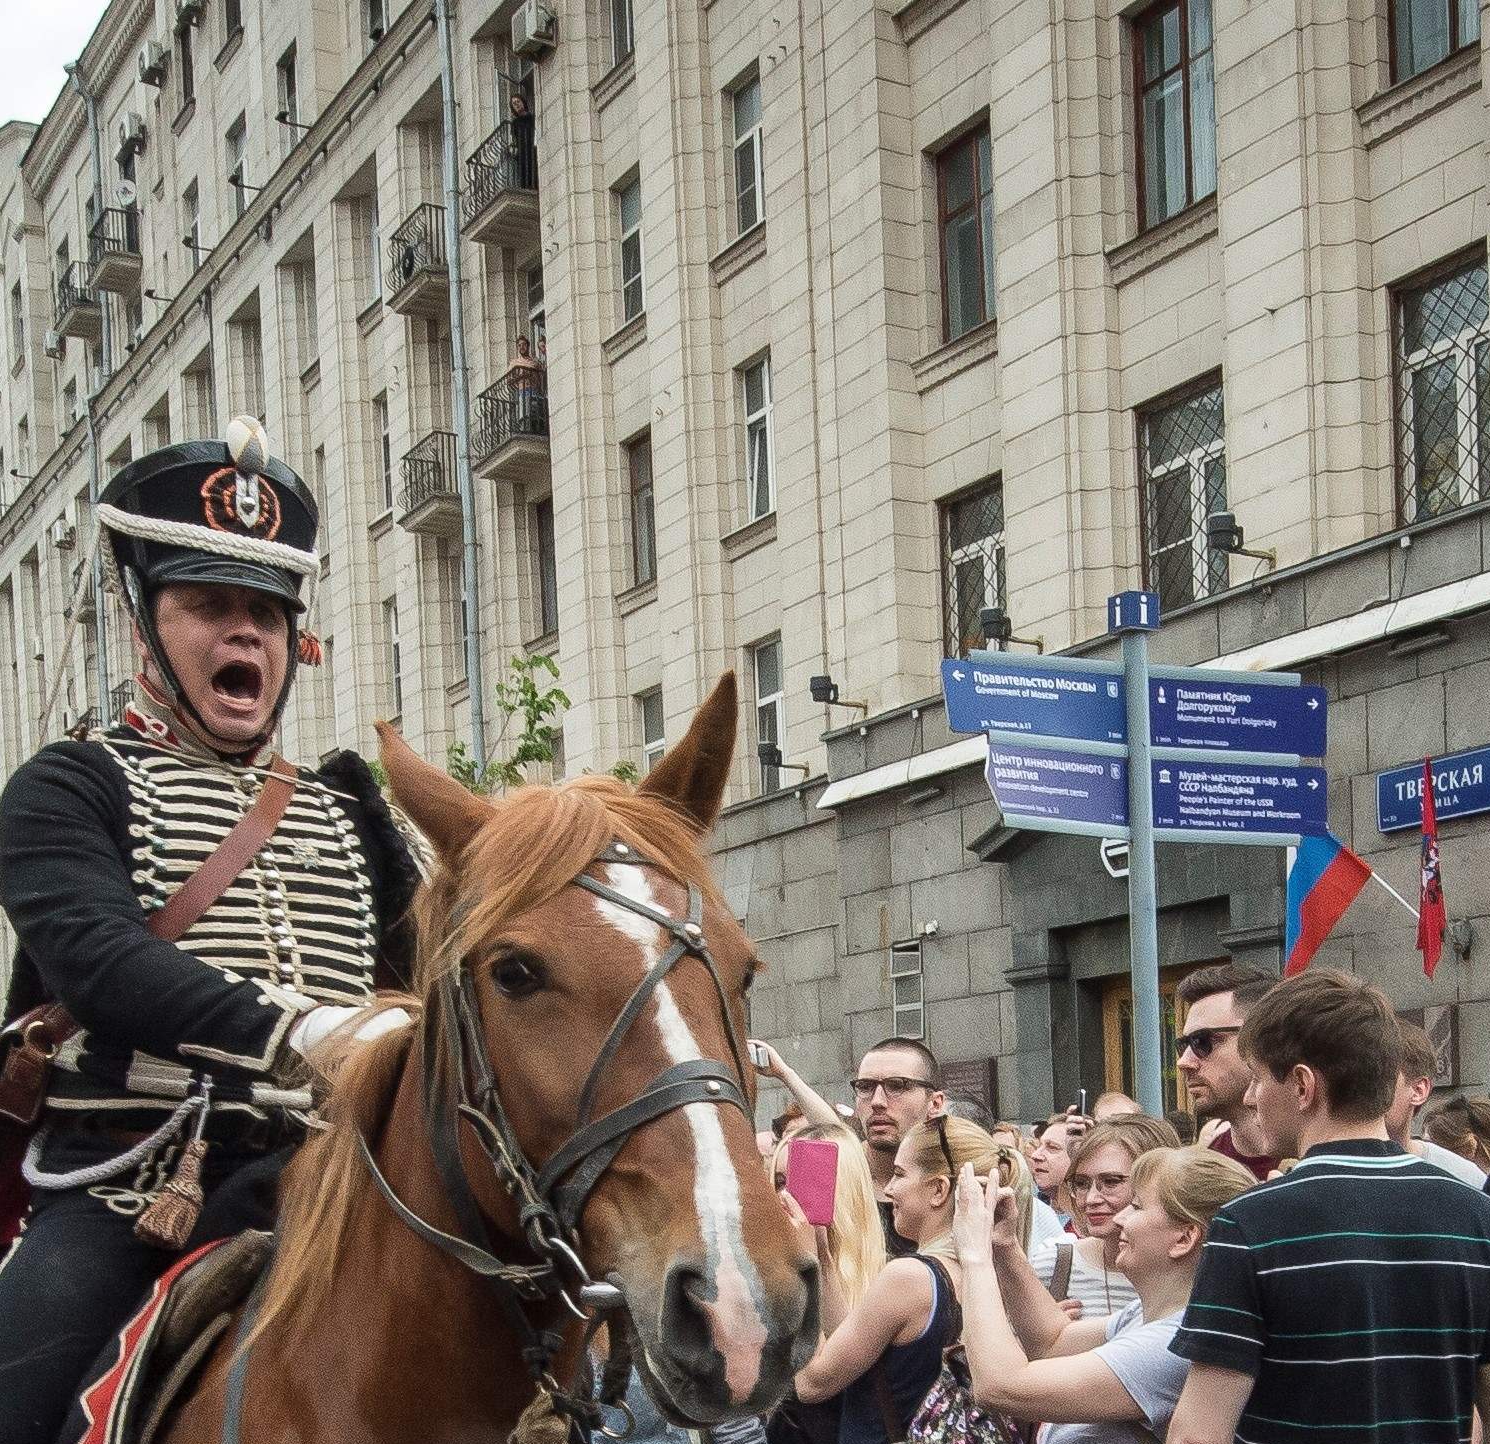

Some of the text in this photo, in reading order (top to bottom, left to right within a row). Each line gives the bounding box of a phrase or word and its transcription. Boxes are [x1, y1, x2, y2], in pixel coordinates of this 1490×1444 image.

[973, 671, 1097, 693] Правительство Москвы
[975, 685, 1059, 700] Government of Moscow
[1176, 688, 1251, 703] Памятник Юрию
[1176, 700, 1237, 715] Долгорукому
[1176, 713, 1216, 724] Monument
[1216, 716, 1225, 724] to
[1226, 716, 1241, 725] Yuri
[991, 752, 1103, 776] Центр инновационного
[994, 767, 1039, 781] развития
[1178, 771, 1298, 790] Музей-мастерская нар. худ.
[1178, 782, 1254, 796] СССР Налбандяна
[1179, 794, 1208, 805] People's
[1208, 796, 1233, 805] Painter
[1234, 796, 1243, 805] of
[1244, 797, 1256, 806] the
[1419, 794, 1460, 812] УИЦА
[1179, 806, 1221, 817] Nalbandyan
[1222, 808, 1251, 817] Museum
[1252, 809, 1266, 818] and
